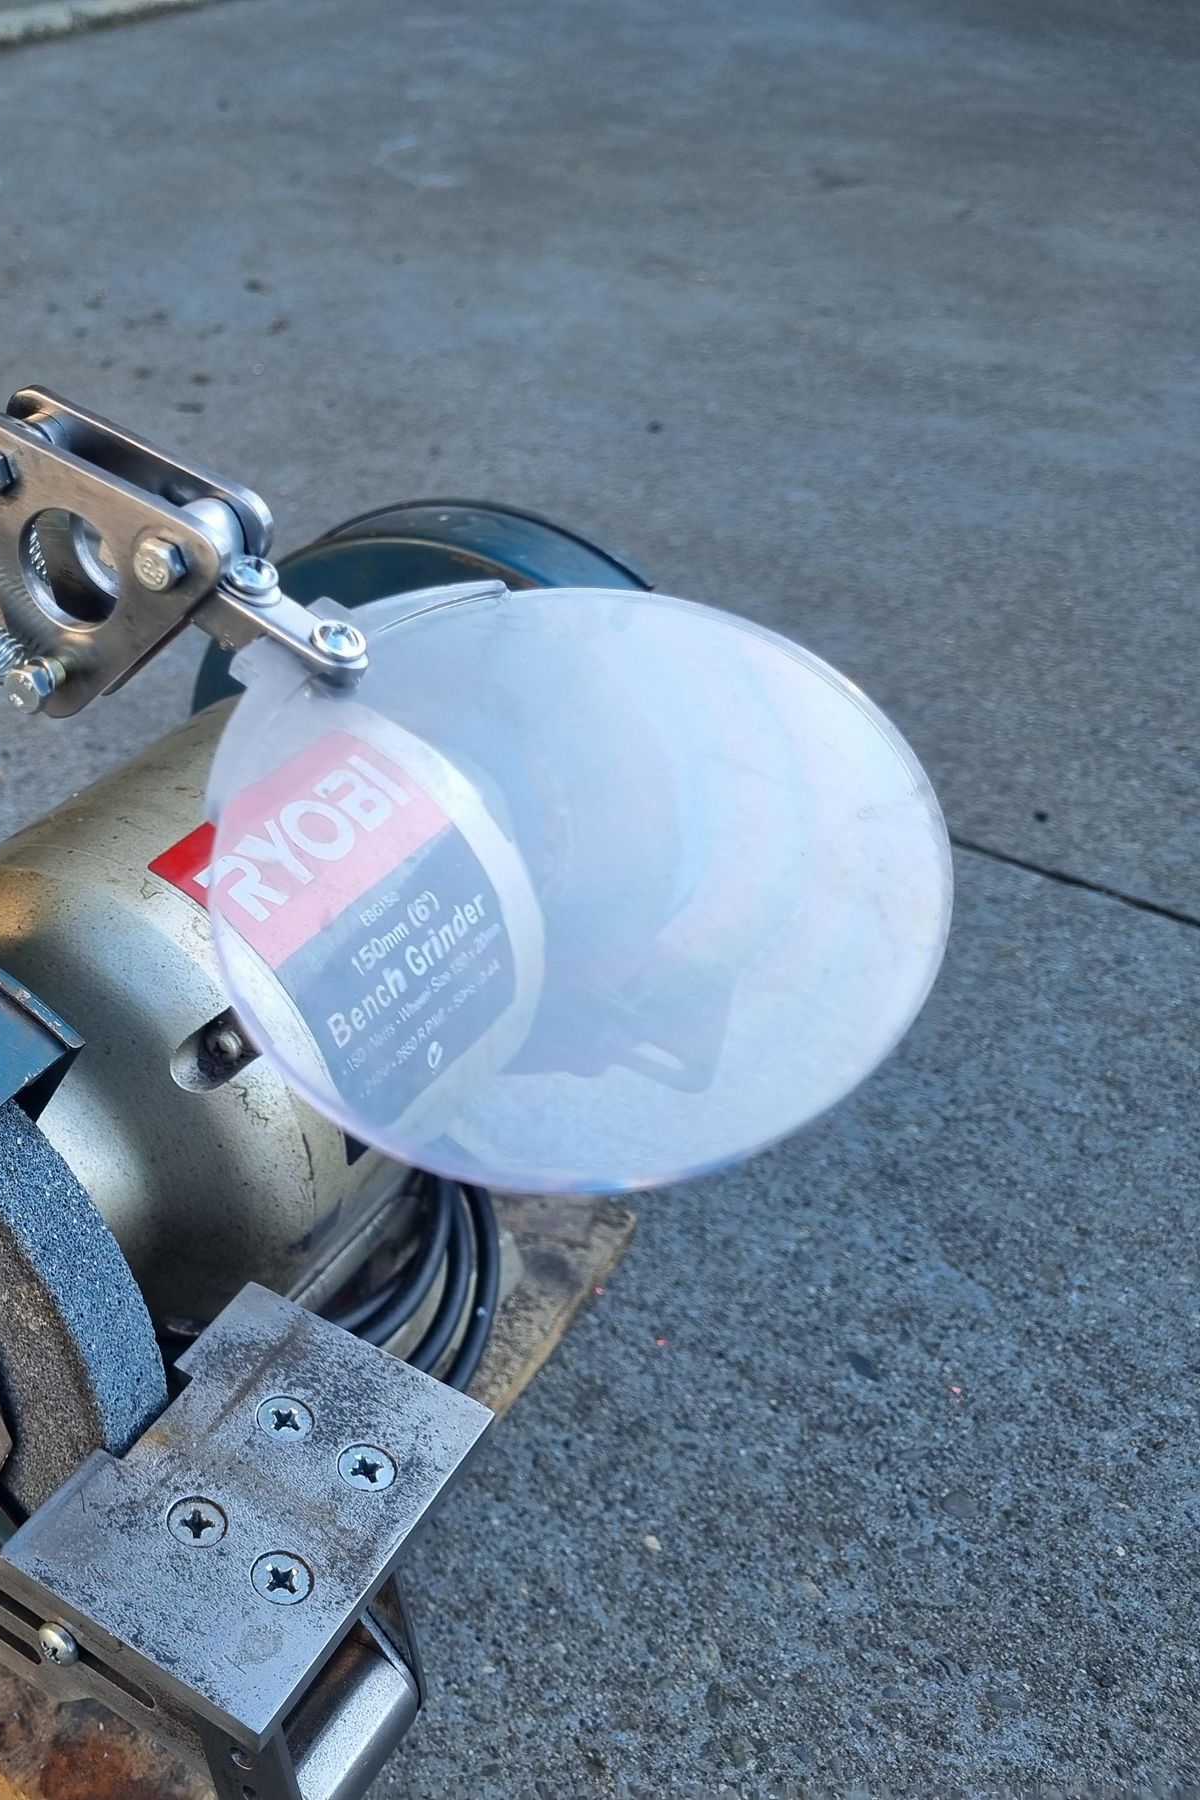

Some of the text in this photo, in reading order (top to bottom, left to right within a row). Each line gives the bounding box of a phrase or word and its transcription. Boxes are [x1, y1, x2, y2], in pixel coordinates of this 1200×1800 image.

[192, 754, 412, 922] RYOBI
[327, 893, 486, 1048] Bench Grinder
[351, 890, 440, 976] 150mm (6")
